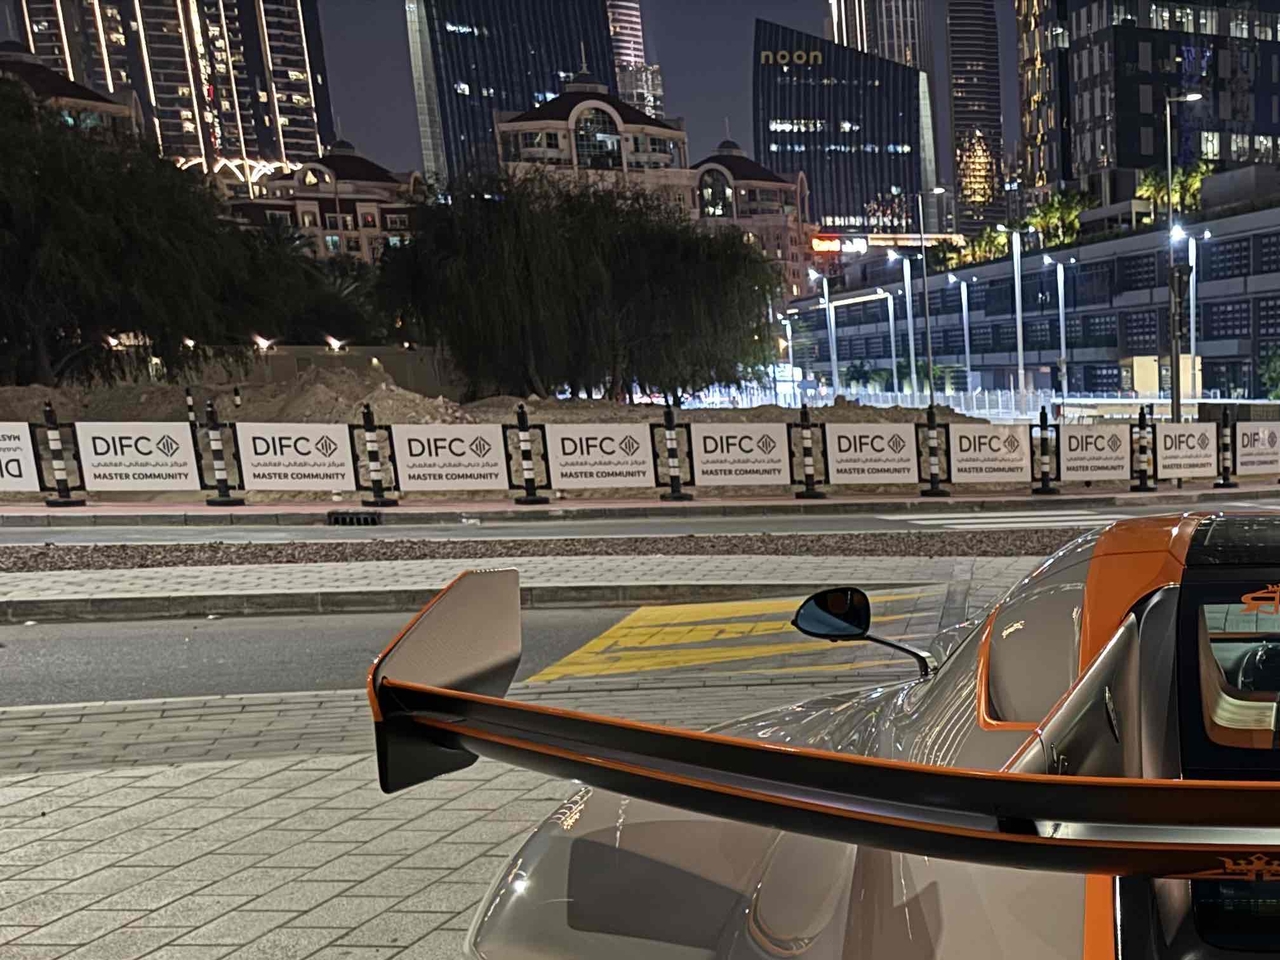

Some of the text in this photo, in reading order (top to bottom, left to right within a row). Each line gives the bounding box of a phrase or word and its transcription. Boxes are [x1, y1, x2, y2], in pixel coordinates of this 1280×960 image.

[761, 51, 822, 64] noon
[91, 436, 153, 456] DIFC
[252, 436, 312, 456] DIFC
[407, 437, 466, 457] DIFC
[561, 436, 616, 456] DIFC
[703, 435, 754, 454] DIFC
[837, 435, 885, 453] DIFC
[959, 435, 1001, 452] DIFC
[1068, 435, 1105, 452] DIFC
[1164, 433, 1196, 450] DIFC
[1242, 432, 1261, 448] DIF
[252, 472, 346, 480] MASTER COMMUNITY
[445, 472, 499, 480] COMMUNITY
[560, 470, 646, 479] MASTER COMMUNITY
[701, 468, 733, 476] MASTER
[836, 467, 866, 475] MASTER
